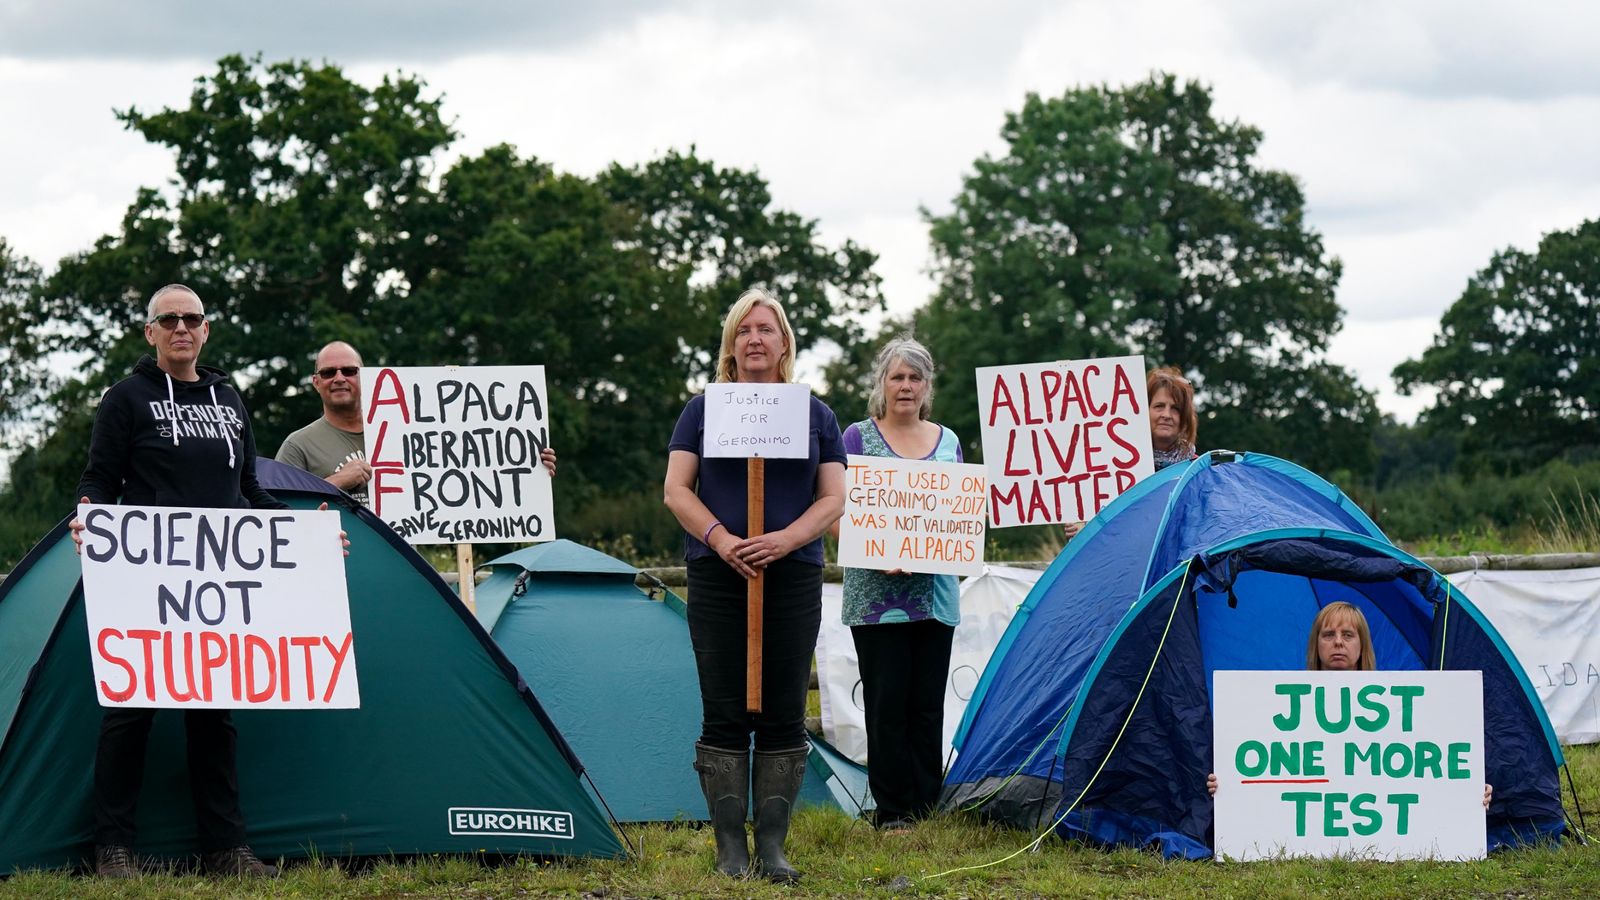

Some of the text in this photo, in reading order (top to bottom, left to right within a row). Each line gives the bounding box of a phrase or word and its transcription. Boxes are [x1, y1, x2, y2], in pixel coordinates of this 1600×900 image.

[149, 399, 243, 425] DEFENDER
[367, 368, 543, 424] ALPACA
[740, 413, 768, 424] FOR
[988, 364, 1140, 427] ALPACA
[370, 421, 548, 469] LIBERATION
[1004, 417, 1140, 477] LIVES
[374, 467, 532, 517] FRONT
[849, 487, 937, 512] GERONIMO
[951, 495, 986, 515] 2017
[907, 471, 950, 491] USED
[961, 476, 985, 494] ON
[85, 508, 297, 572] SCIENCE
[438, 514, 543, 543] GERONIMO
[850, 513, 984, 536] WAS NOT VALIDATED
[865, 536, 975, 562] IN ALPACAS
[157, 579, 263, 626] NOT
[97, 627, 353, 704] STUPIDITY
[1272, 683, 1425, 734] JUST
[1235, 740, 1471, 780] ONE MORE
[455, 813, 567, 833] EUROHIKE
[1281, 791, 1420, 837] TEST
